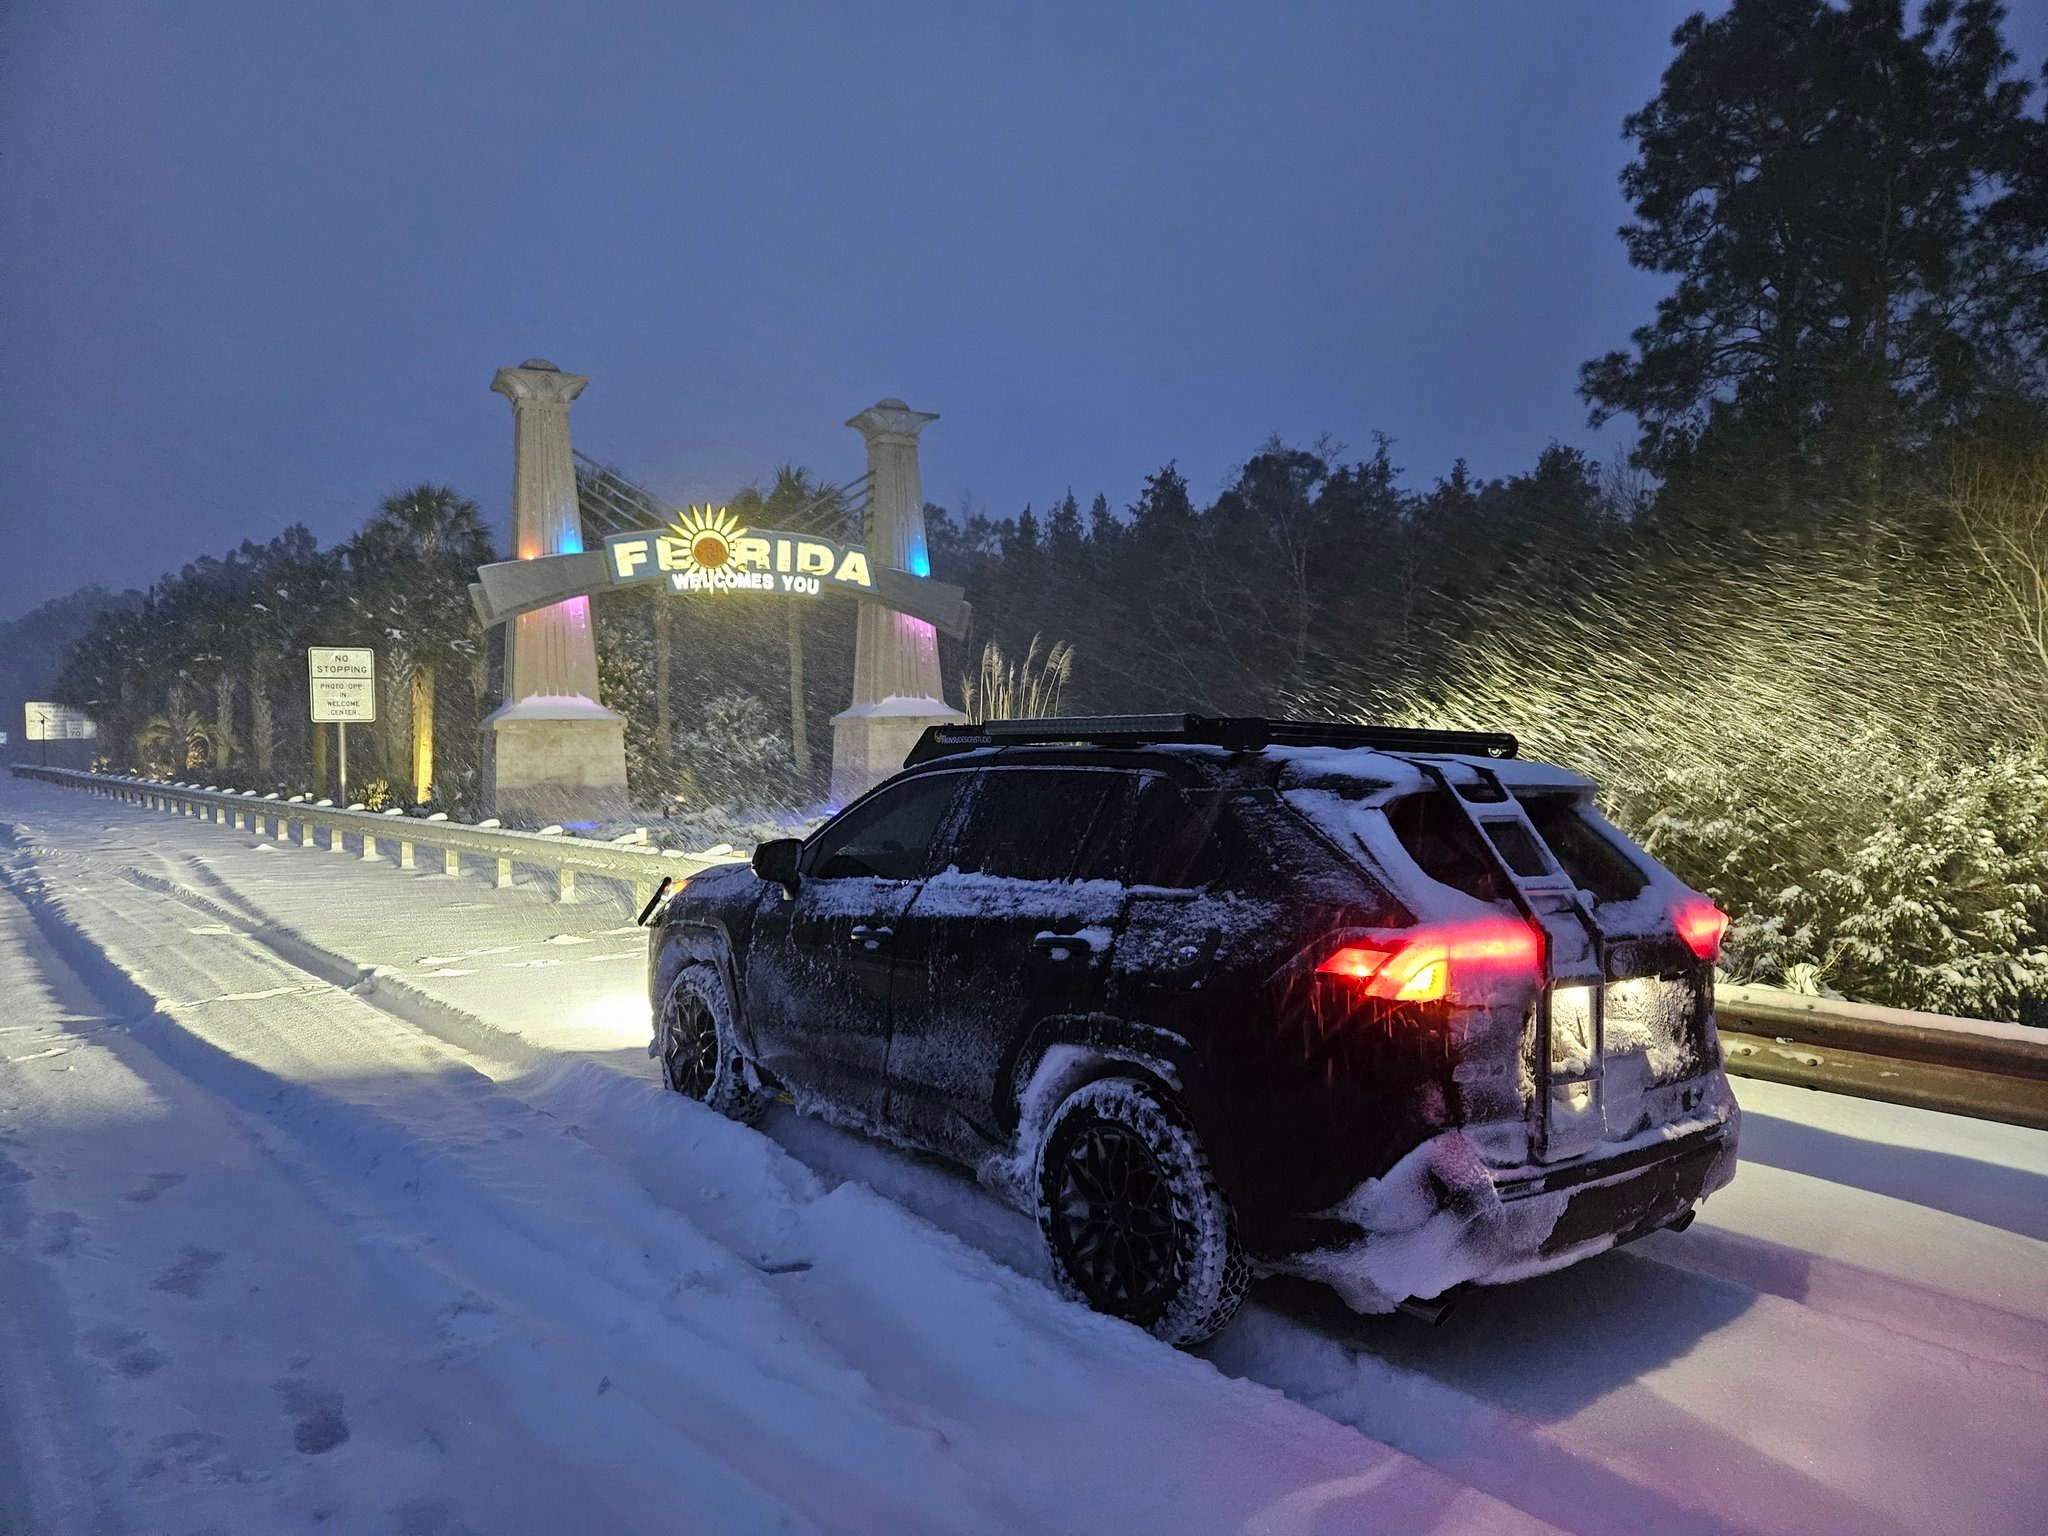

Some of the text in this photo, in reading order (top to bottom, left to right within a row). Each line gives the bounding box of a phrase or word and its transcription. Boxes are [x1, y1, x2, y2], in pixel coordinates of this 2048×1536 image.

[613, 537, 872, 587] FLORIDA
[672, 573, 820, 595] WELCOMES YOU
[334, 654, 349, 663] NO
[317, 665, 368, 674] STOPPING
[327, 700, 361, 708] WELCOME
